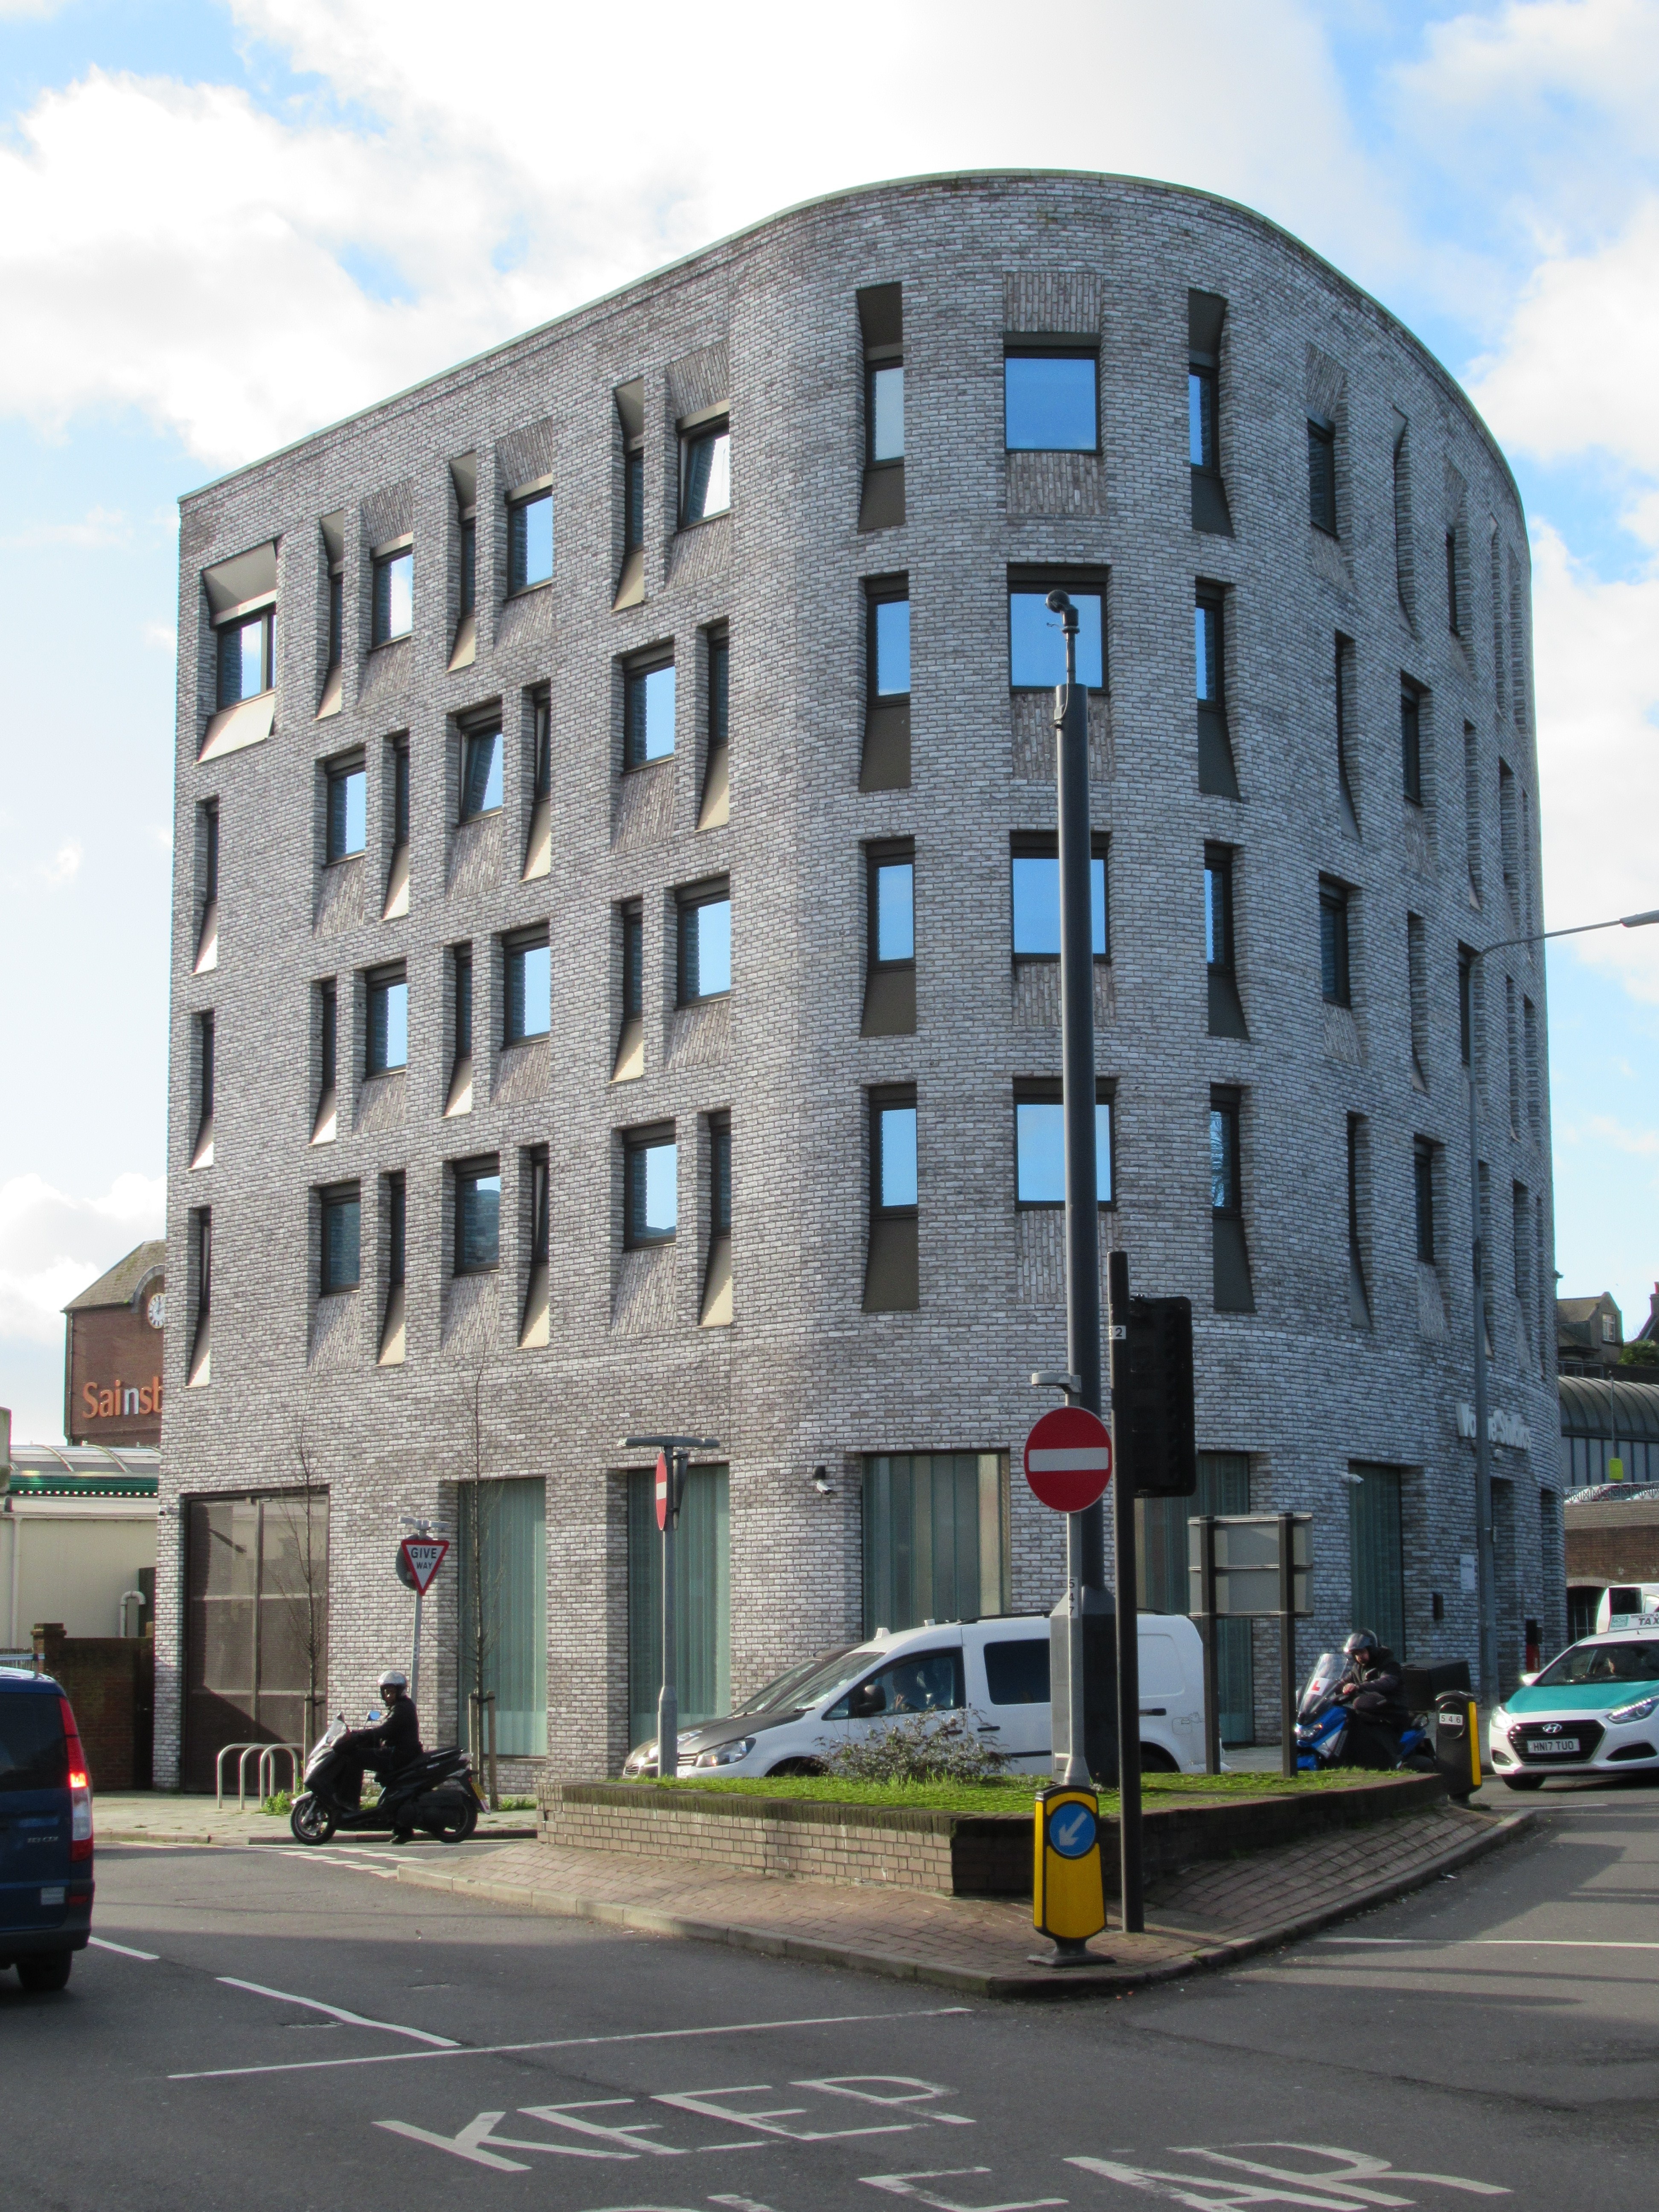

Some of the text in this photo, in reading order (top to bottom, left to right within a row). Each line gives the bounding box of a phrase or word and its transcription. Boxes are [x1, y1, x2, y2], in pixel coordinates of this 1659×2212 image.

[411, 1547, 437, 1559] GIVE
[416, 1562, 433, 1570] WAY
[1311, 1680, 1321, 1691] L
[1534, 1741, 1553, 1751] HN17
[371, 2075, 977, 2172] KEEP
[578, 2141, 1514, 2212] EAR
